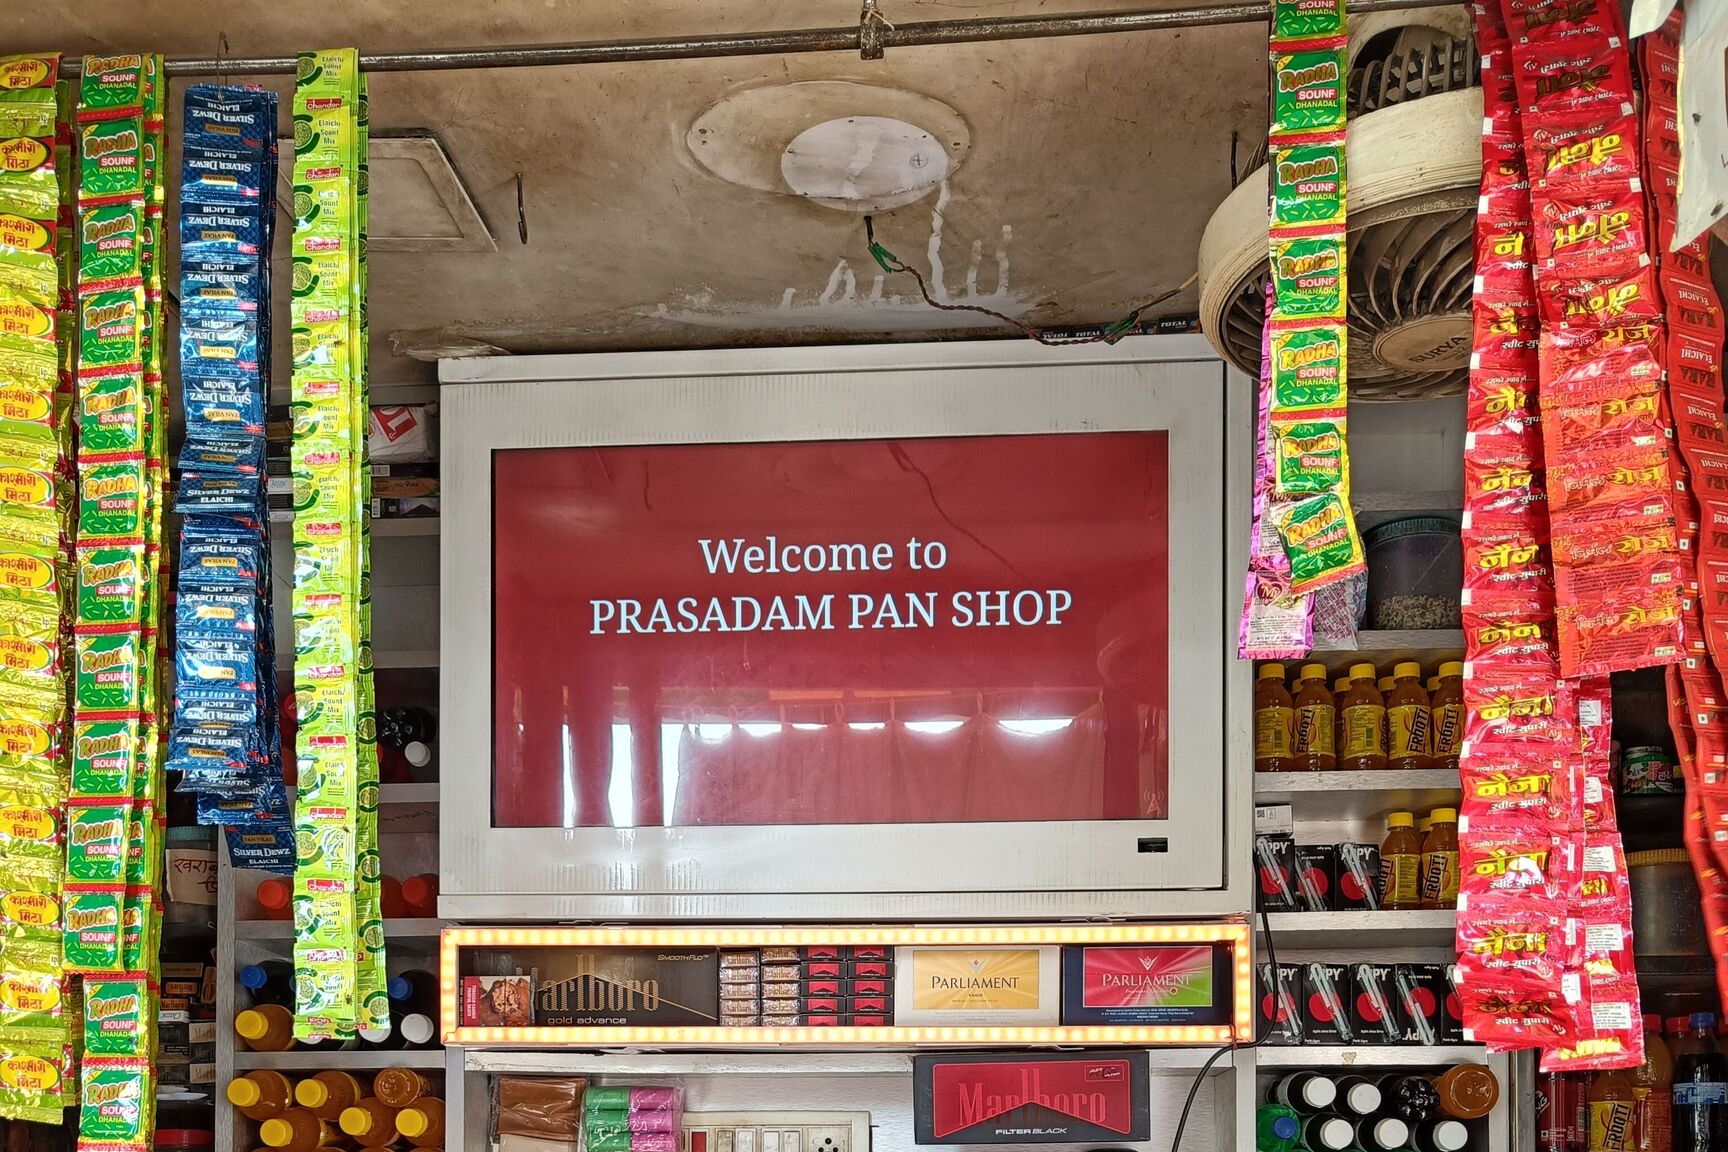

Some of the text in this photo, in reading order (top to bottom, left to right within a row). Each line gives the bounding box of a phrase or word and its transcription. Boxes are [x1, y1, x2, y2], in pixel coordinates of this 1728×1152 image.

[87, 55, 140, 75] RADHA
[98, 82, 137, 90] DHANADAL
[102, 74, 136, 82] SOUNF
[1279, 64, 1338, 89] RADHA
[1295, 100, 1338, 109] DHANADAL
[1298, 89, 1336, 100] SOUNF
[1279, 159, 1337, 183] RADHA
[1298, 183, 1335, 193] SOUNF
[84, 215, 134, 242] RADHA
[96, 249, 134, 258] DHANADAL
[98, 239, 132, 249] SOUNF
[1279, 343, 1338, 370] RADHA
[1408, 336, 1468, 363] SURYA
[1296, 378, 1338, 387] DHANADAL
[1299, 367, 1337, 378] SOUNF
[84, 476, 137, 499] RADHA
[98, 509, 137, 517] DHANADAL
[101, 500, 135, 509] SOUNF
[1287, 504, 1342, 545] RADHA
[1306, 529, 1346, 549] SOUNF
[698, 536, 948, 574] Welcome to
[589, 589, 1072, 635] PRASADAM PAN SHOP
[1409, 708, 1429, 753] FROOTI
[1476, 771, 1552, 797] नैना
[234, 848, 291, 857] SILVER DEWZ
[516, 954, 659, 1012] arlboro
[931, 975, 1020, 989] PARLIAMENT
[1102, 973, 1191, 987] PARLIAMENT
[548, 1016, 627, 1025] gold advance
[958, 1068, 1106, 1126] Marlboro
[1606, 1104, 1629, 1151] FROOTI
